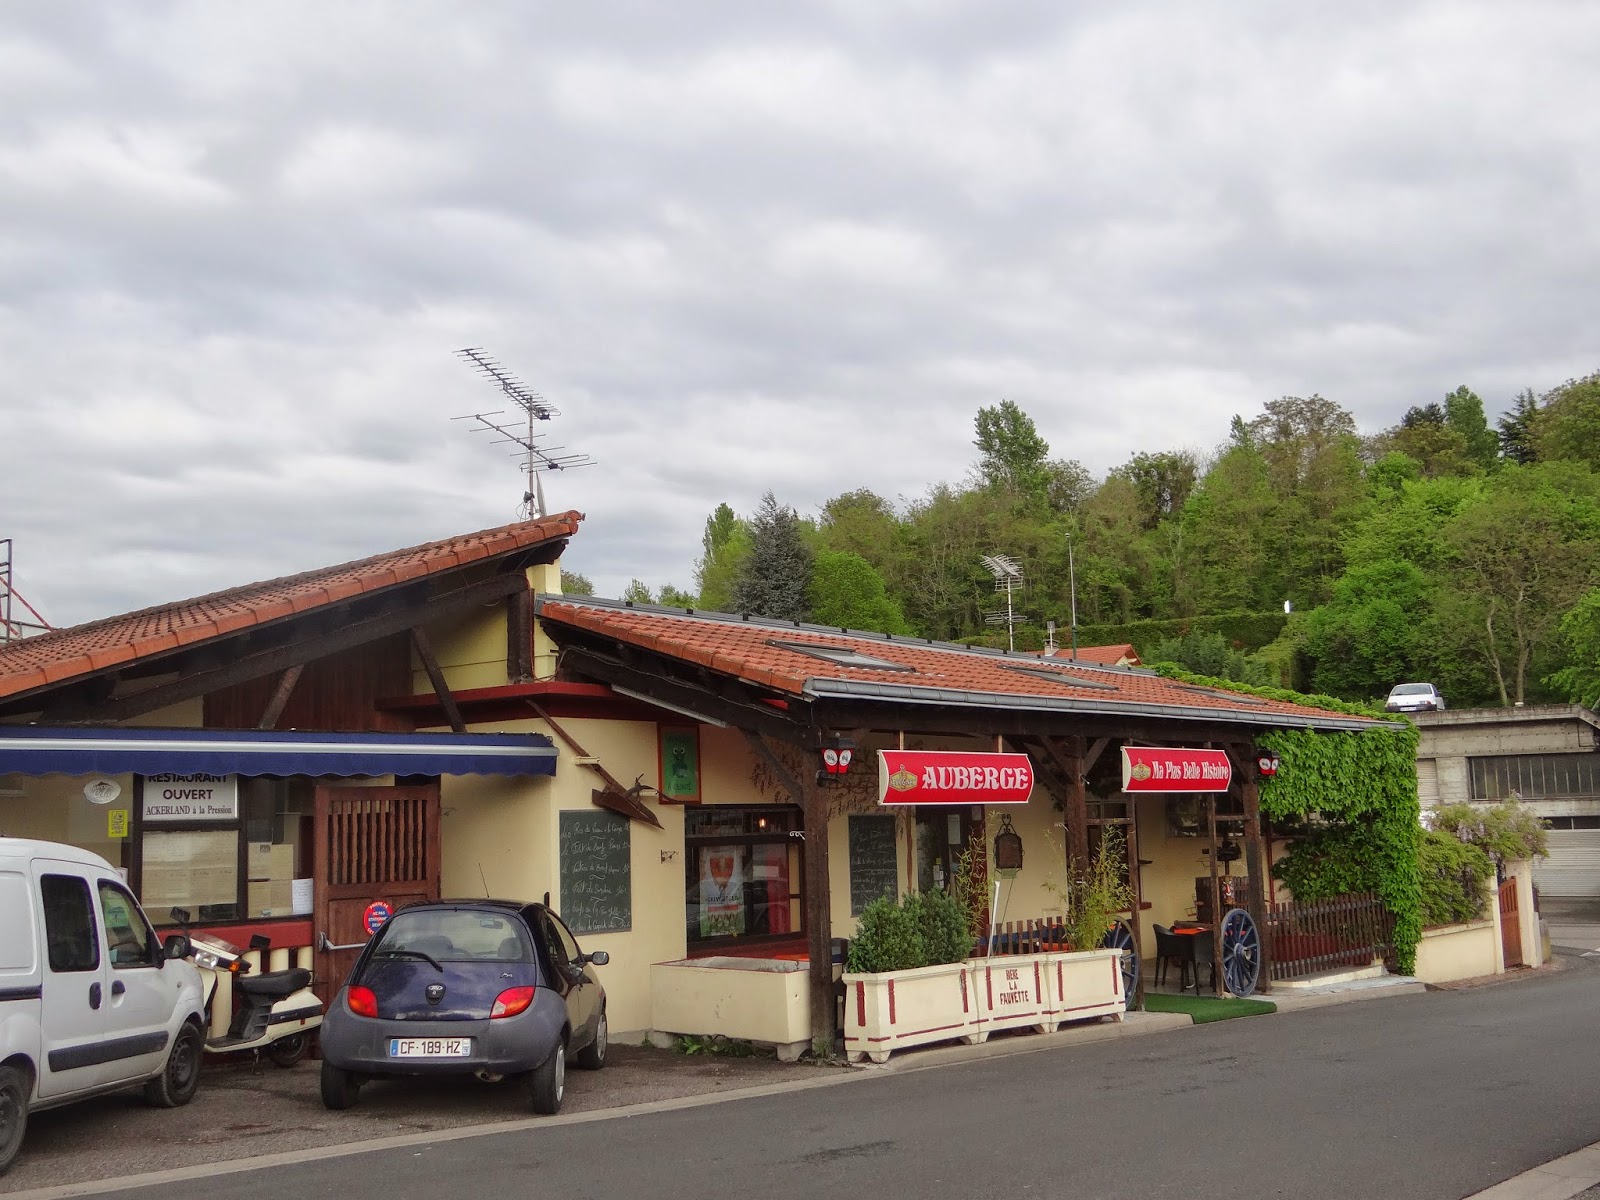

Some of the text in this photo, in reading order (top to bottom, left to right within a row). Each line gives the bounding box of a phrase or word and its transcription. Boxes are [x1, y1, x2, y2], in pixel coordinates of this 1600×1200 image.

[1151, 760, 1164, 780] Ma
[1165, 760, 1182, 780] Plus
[1182, 761, 1200, 780] Belle
[1201, 761, 1229, 780] Histoire
[148, 773, 227, 783] RESTAURANT
[921, 765, 1029, 790] AUBERGE
[162, 789, 214, 800] OUVERT
[146, 805, 191, 816] ACKERLAND
[199, 805, 205, 814] la
[207, 804, 232, 815] Pression
[999, 990, 1029, 1005] FAUVETTE
